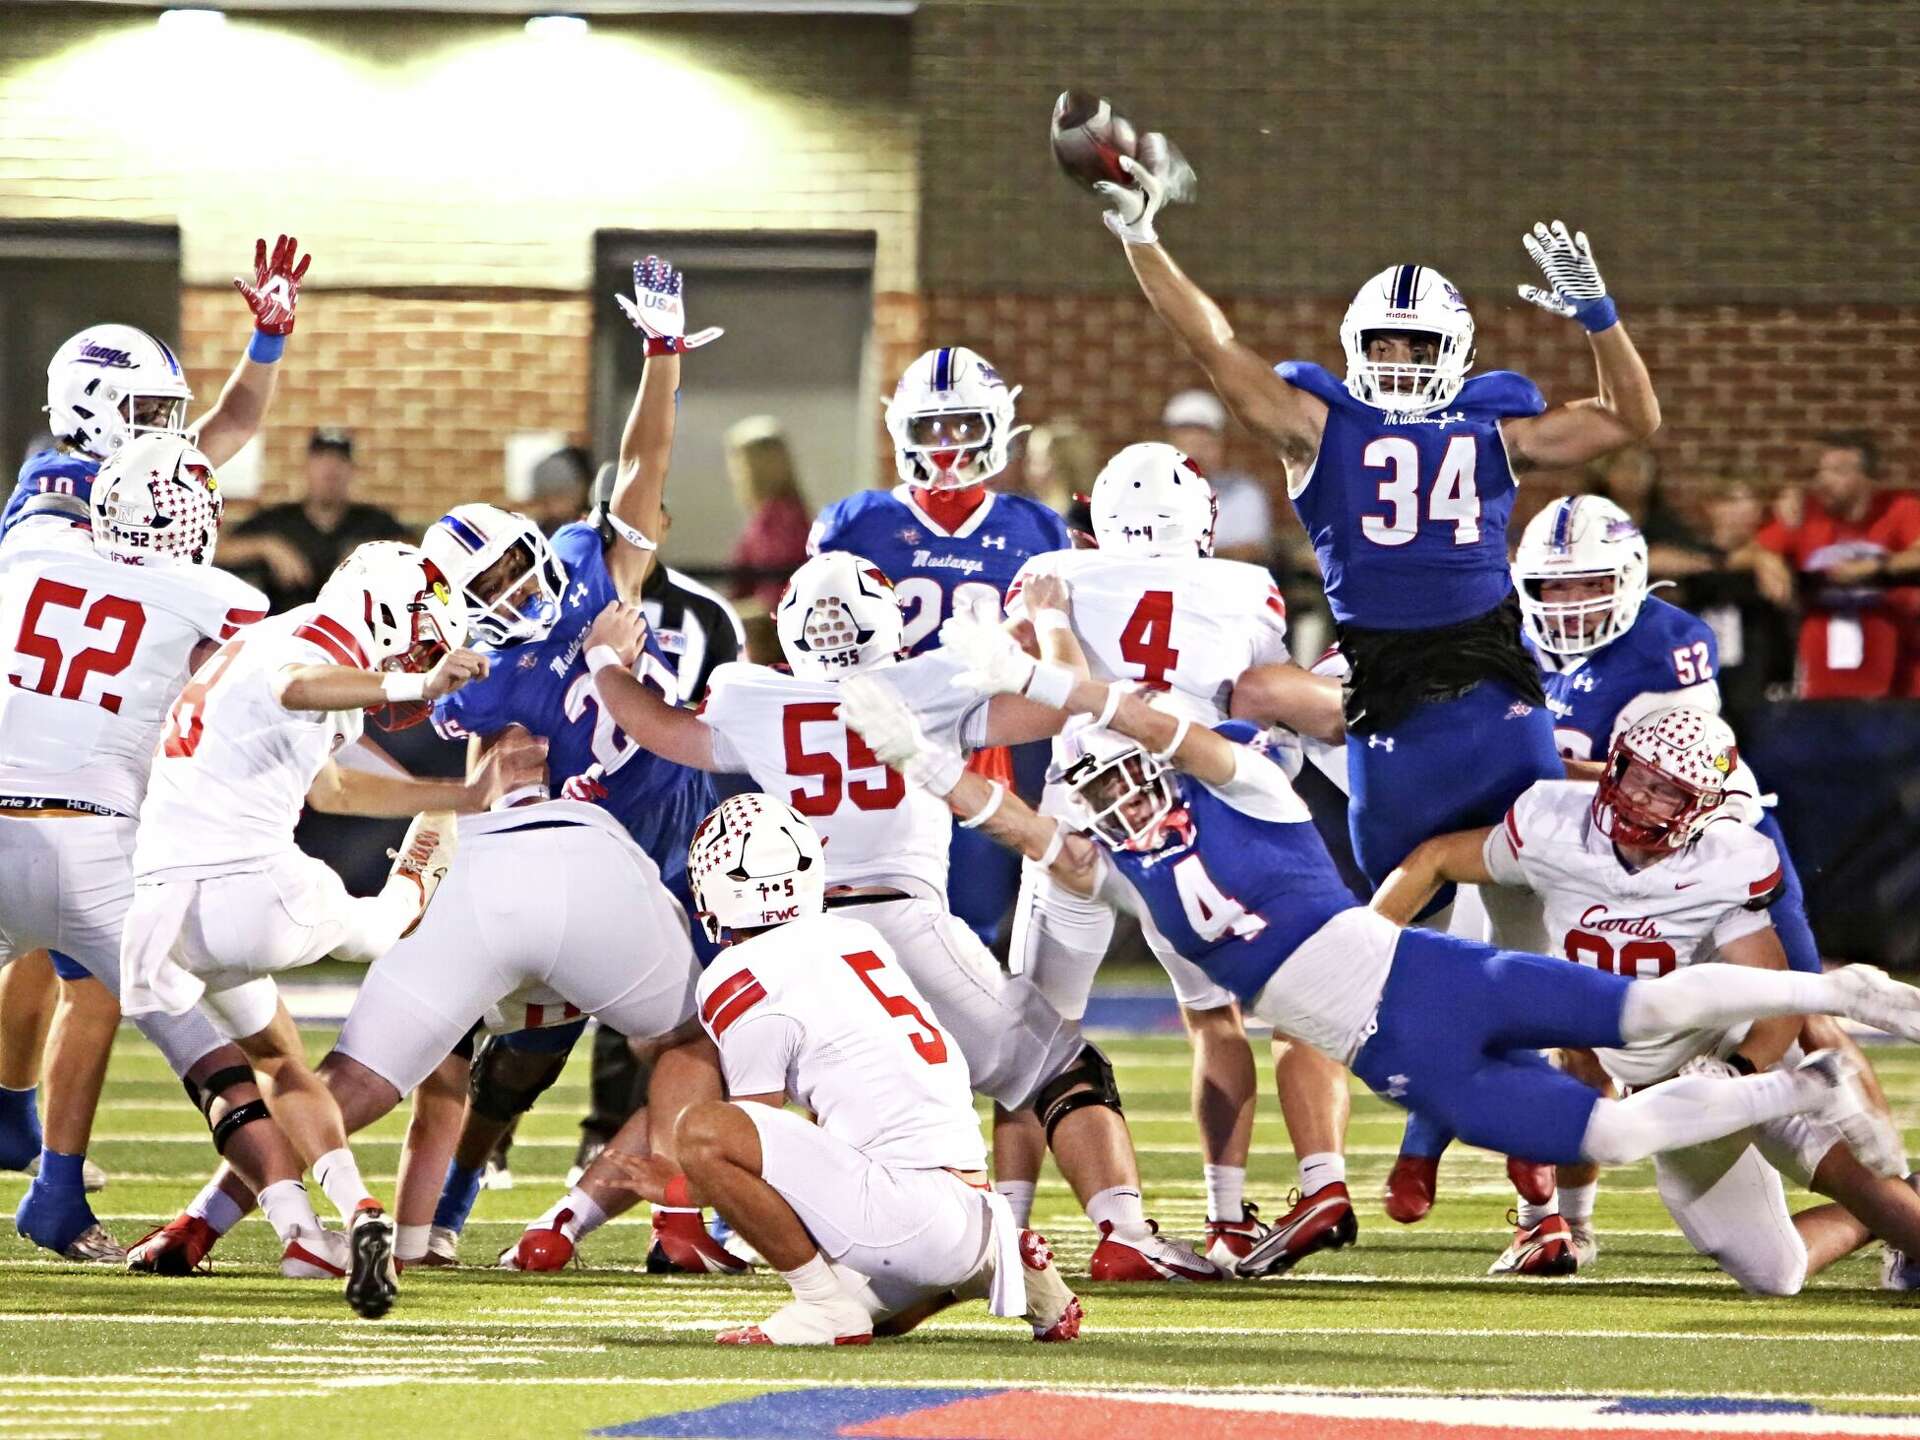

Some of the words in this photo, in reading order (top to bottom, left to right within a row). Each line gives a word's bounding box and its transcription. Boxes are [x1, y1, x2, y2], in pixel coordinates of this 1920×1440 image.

[644, 294, 678, 315] USA
[1362, 436, 1481, 546] 34
[130, 531, 150, 547] 52
[1142, 525, 1153, 542] 4
[911, 550, 984, 576] Mustangs
[893, 577, 1001, 650] 2
[8, 577, 147, 716] 52
[838, 649, 861, 668] 55
[1119, 590, 1179, 693] 4
[1673, 641, 1714, 687] 52
[782, 701, 906, 817] 55
[66, 799, 117, 817] Hurley
[784, 878, 794, 897] 5
[1172, 853, 1268, 942] 4
[1580, 904, 1662, 939] Cards
[840, 950, 948, 1065] 5
